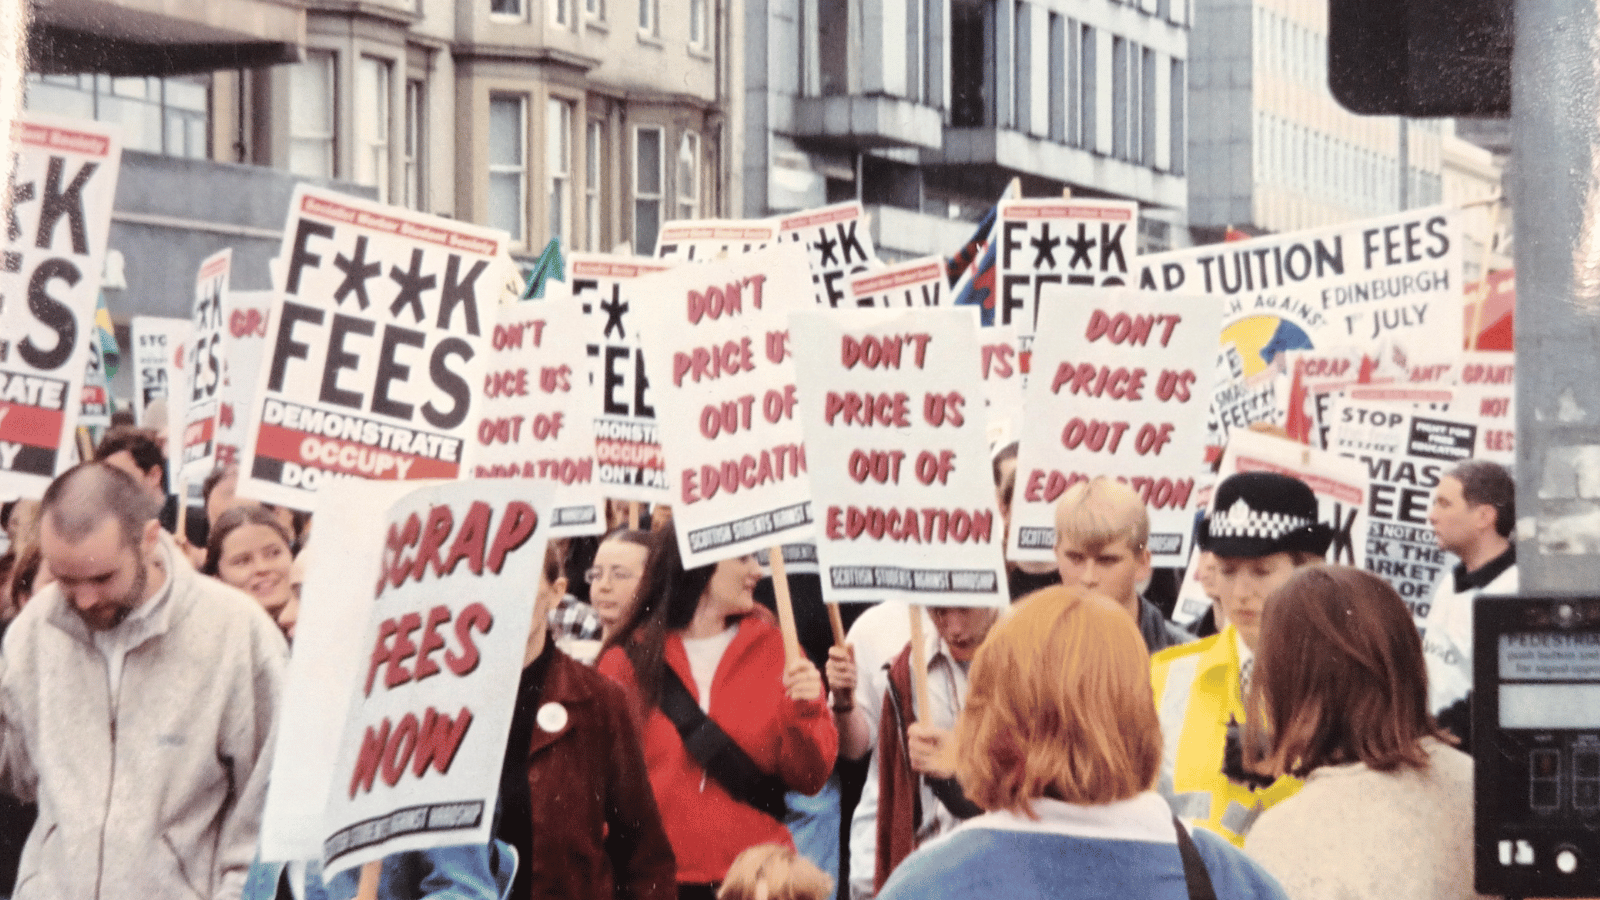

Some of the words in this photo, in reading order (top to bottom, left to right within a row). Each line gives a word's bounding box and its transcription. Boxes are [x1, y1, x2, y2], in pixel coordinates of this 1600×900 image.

[1197, 235, 1344, 295] TUITION
[1364, 215, 1450, 270] FEES
[687, 273, 766, 325] DON'T
[1321, 269, 1449, 310] EDINBURGH
[492, 319, 546, 352] ON'T
[1085, 309, 1181, 348] DON'T
[1372, 303, 1427, 340] JULY
[267, 300, 475, 430] FEES
[673, 336, 756, 388] PRICE
[841, 332, 931, 370] DON'T
[539, 364, 572, 394] US
[1051, 361, 1147, 400] PRICE
[1155, 369, 1196, 402] US
[477, 415, 525, 446] OUT
[532, 411, 564, 441] OF
[699, 394, 755, 440] OUT
[762, 384, 798, 424] OF
[825, 391, 911, 427] PRICE
[923, 391, 966, 428] US
[1341, 407, 1403, 428] STOP
[264, 400, 459, 462] DEMONSTRATE
[1061, 417, 1129, 454] OUT
[1134, 422, 1175, 455] OF
[300, 437, 414, 481] OCCUPY
[600, 463, 639, 485] ON'T
[848, 448, 906, 486] OUT
[915, 449, 957, 486] OF
[1360, 454, 1442, 488] MAS
[1368, 483, 1430, 524] EE
[825, 505, 993, 544] EDUCATION
[1365, 557, 1441, 582] ARKET
[1401, 544, 1446, 565] THE
[1400, 581, 1431, 598] OF
[364, 602, 494, 699] FEES
[348, 706, 473, 800] NOW
